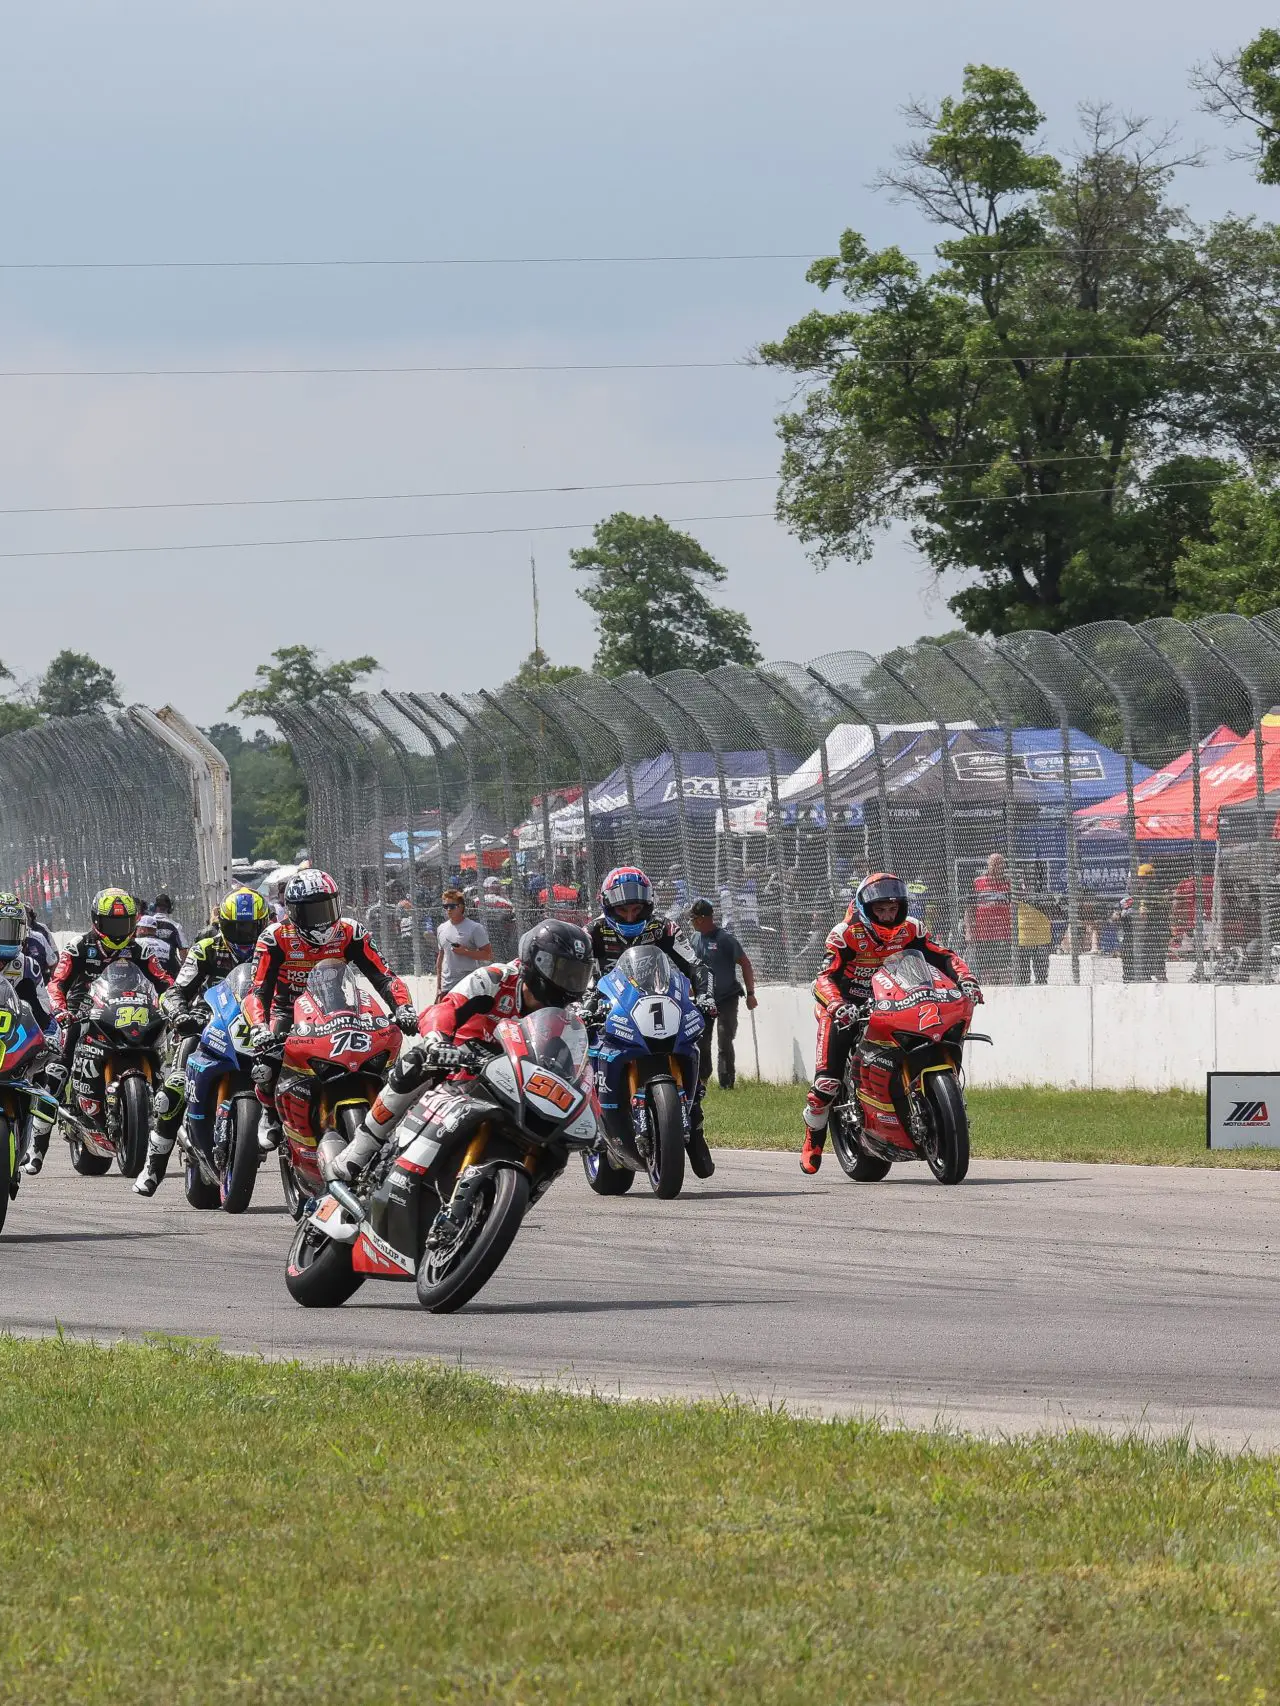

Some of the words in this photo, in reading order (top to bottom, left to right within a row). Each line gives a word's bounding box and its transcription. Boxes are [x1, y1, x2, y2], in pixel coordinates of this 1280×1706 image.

[895, 990, 928, 1006] MOUNT
[115, 1006, 149, 1028] 34
[315, 1016, 351, 1033] MOUNT
[649, 1002, 665, 1031] 1
[919, 1003, 942, 1031] 2
[329, 1030, 373, 1059] 76
[524, 1073, 576, 1113] 50
